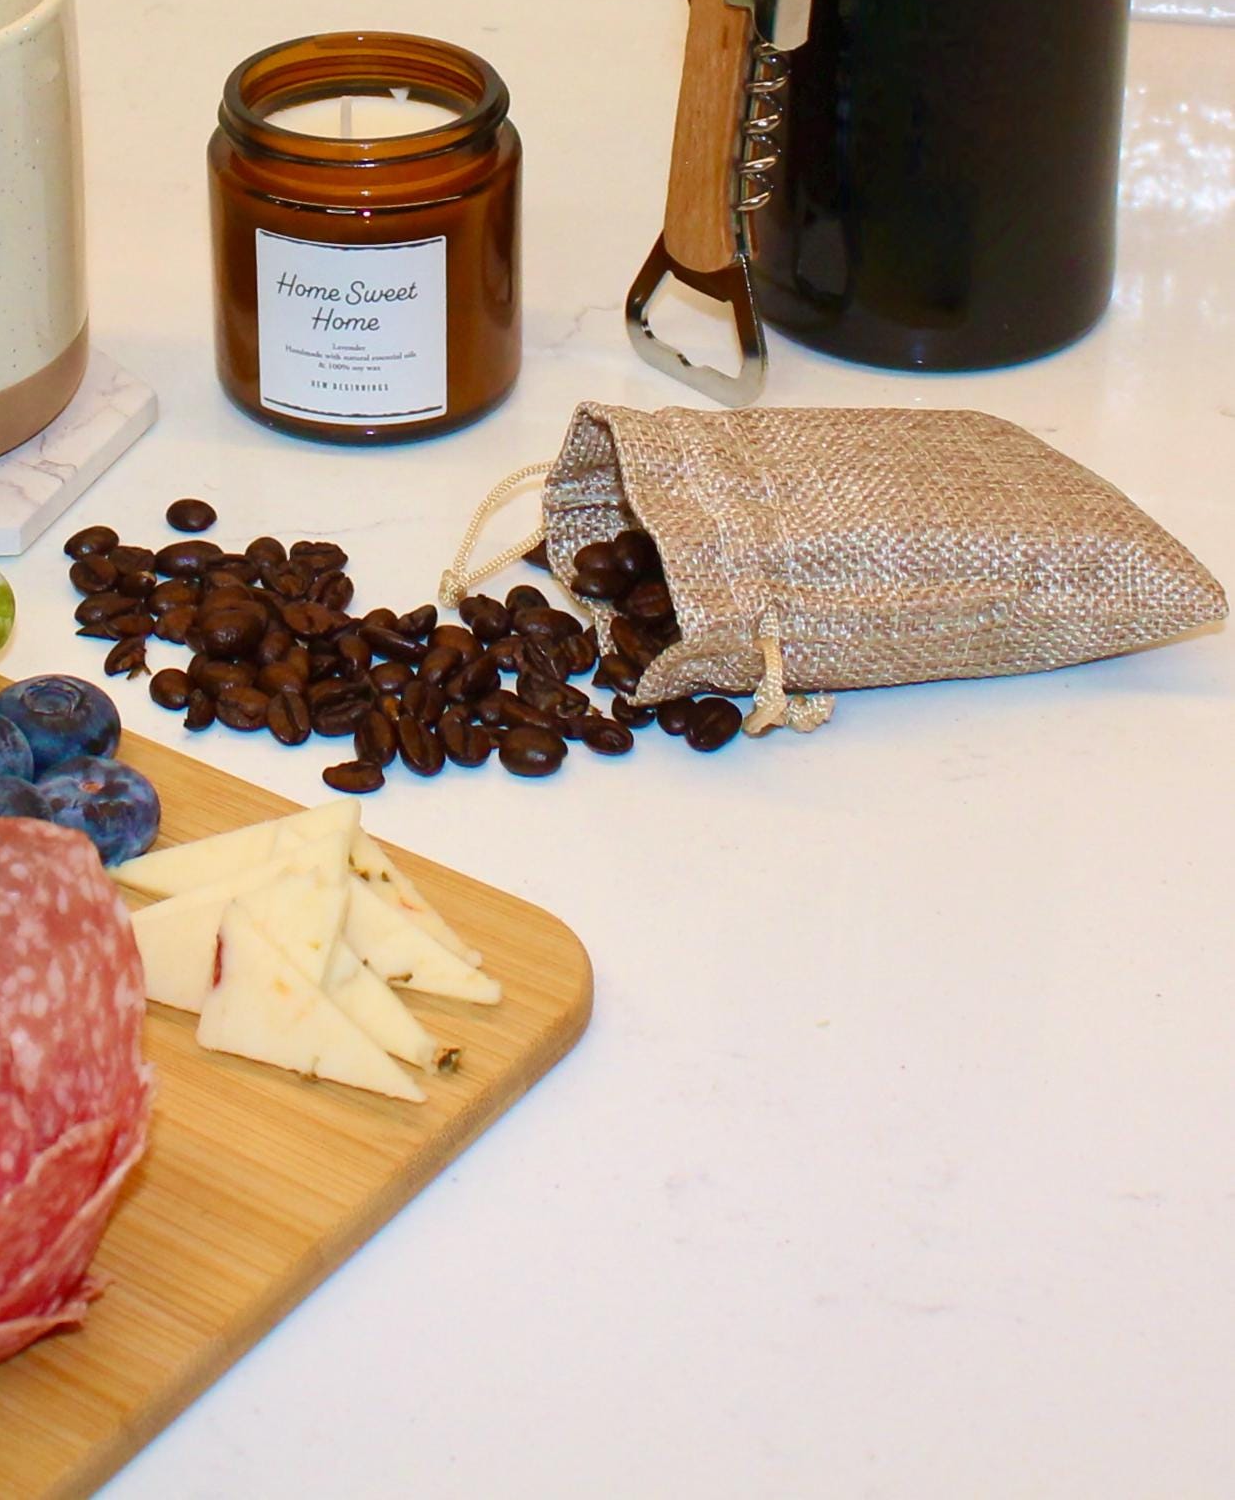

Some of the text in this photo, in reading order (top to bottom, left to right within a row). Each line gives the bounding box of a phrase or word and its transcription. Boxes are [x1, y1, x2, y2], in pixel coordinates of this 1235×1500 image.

[276, 272, 418, 305] Home Sweet
[312, 307, 380, 331] Home
[285, 345, 323, 358] Handmade
[332, 343, 366, 351] Lavender
[329, 362, 350, 371] 100%
[333, 383, 389, 391] BEGINNINGS
